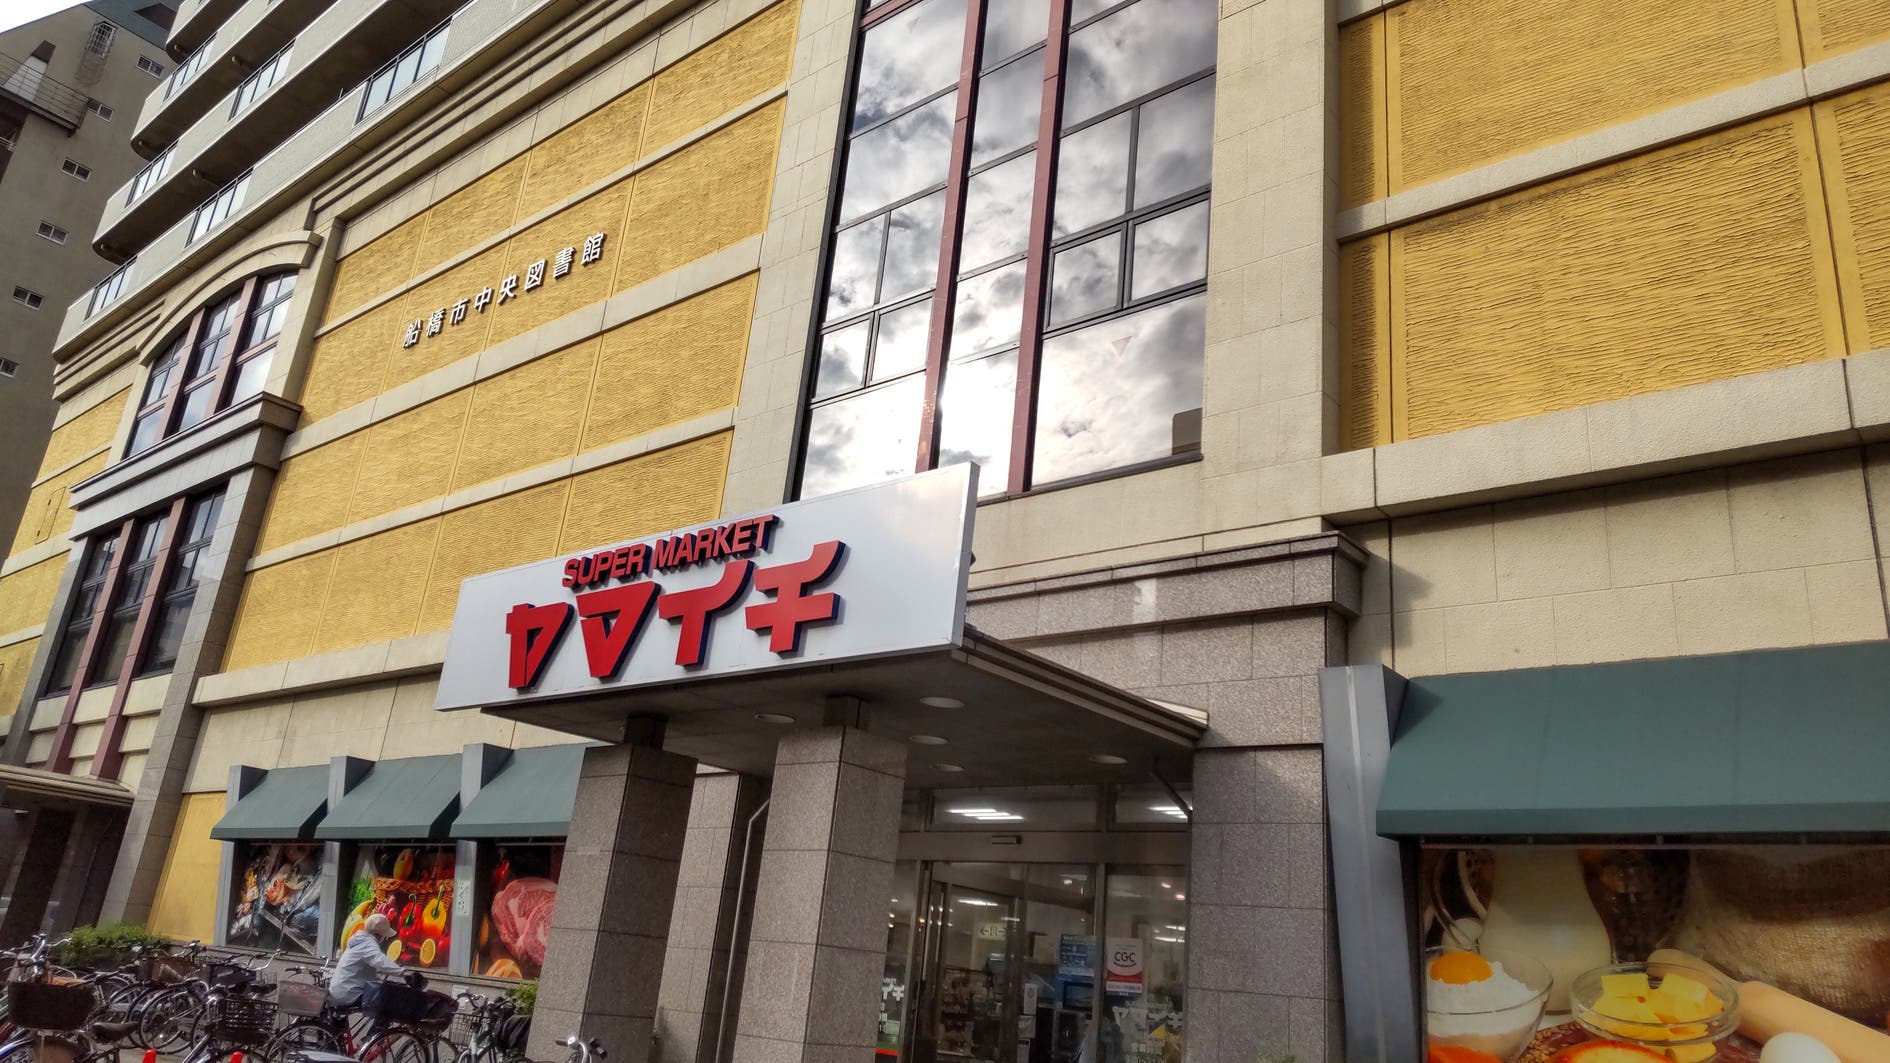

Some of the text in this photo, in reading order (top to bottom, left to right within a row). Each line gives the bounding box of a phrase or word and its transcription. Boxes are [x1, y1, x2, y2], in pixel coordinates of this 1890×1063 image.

[402, 232, 606, 348] 船橋市中央図書館
[562, 514, 780, 589] SUPER MARKET
[506, 540, 846, 690] ヤマイチ
[1114, 951, 1137, 963] CGC
